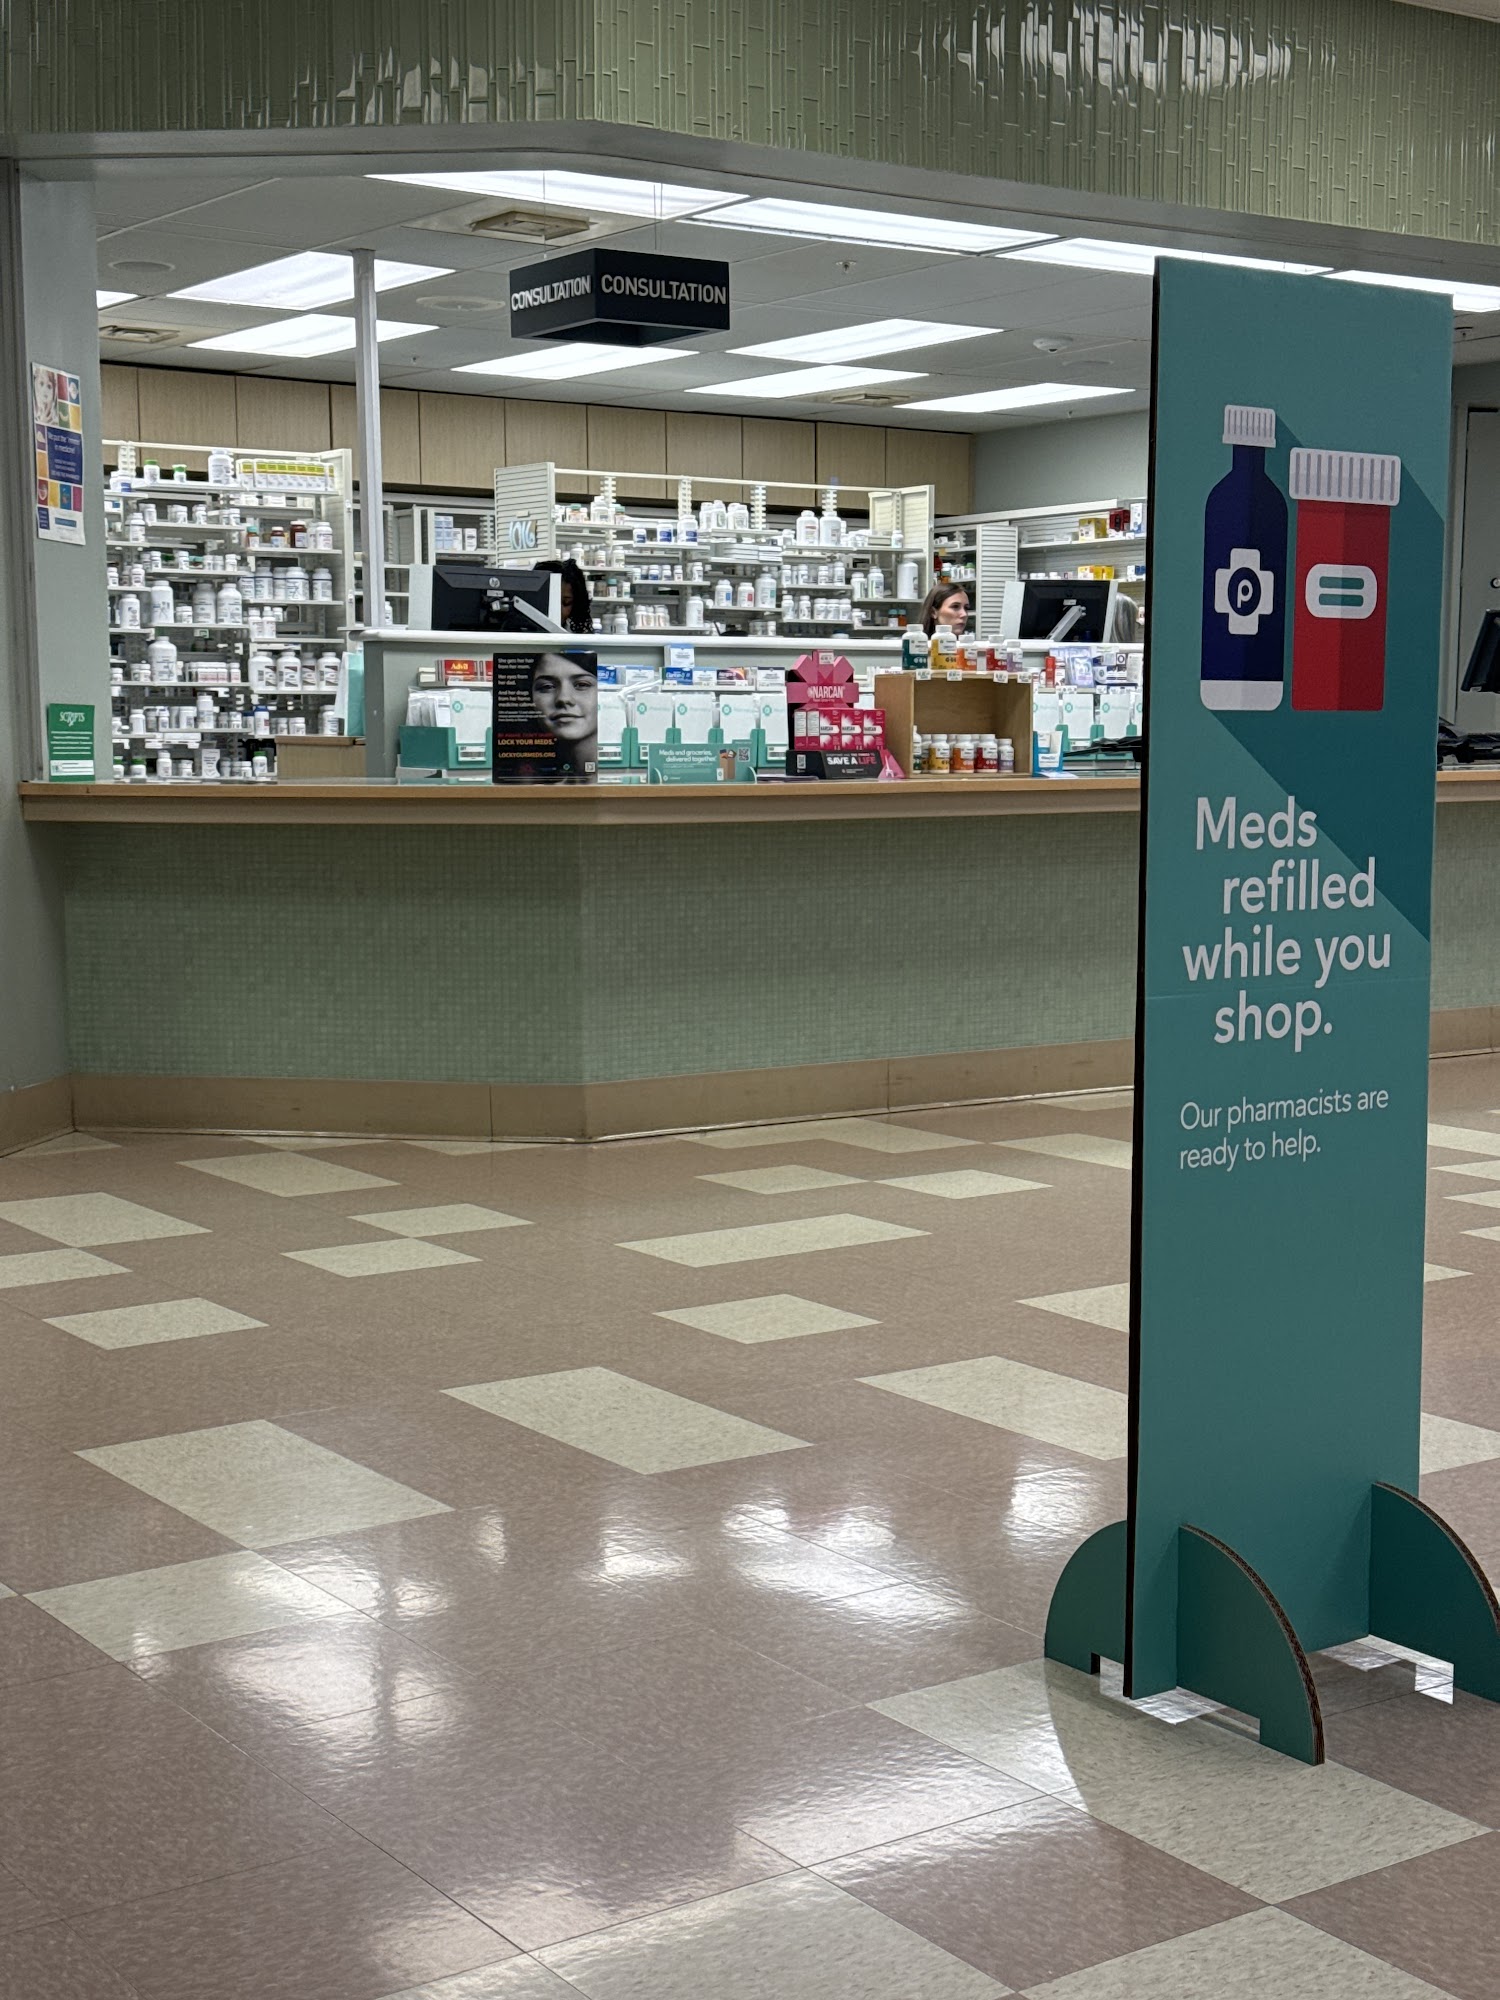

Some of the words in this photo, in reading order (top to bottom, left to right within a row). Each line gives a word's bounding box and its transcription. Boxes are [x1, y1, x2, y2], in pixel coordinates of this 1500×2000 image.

[511, 275, 591, 311] CONSULTATION
[601, 274, 727, 304] CONSULTATION
[451, 662, 469, 670] Advil
[813, 686, 843, 698] NARCAN
[827, 757, 850, 765] SAVE
[851, 757, 858, 765] A
[858, 757, 877, 765] LIFE
[1196, 795, 1317, 850] Meds
[1223, 856, 1375, 914] refilled
[1182, 924, 1301, 981] while
[1314, 932, 1391, 989] you
[1213, 990, 1333, 1053] shop.
[1180, 1101, 1223, 1130] Our
[1227, 1088, 1352, 1133] pharmacists
[1356, 1089, 1389, 1111] are
[1180, 1136, 1239, 1172] ready
[1244, 1138, 1265, 1162] to
[1271, 1129, 1321, 1162] help.
